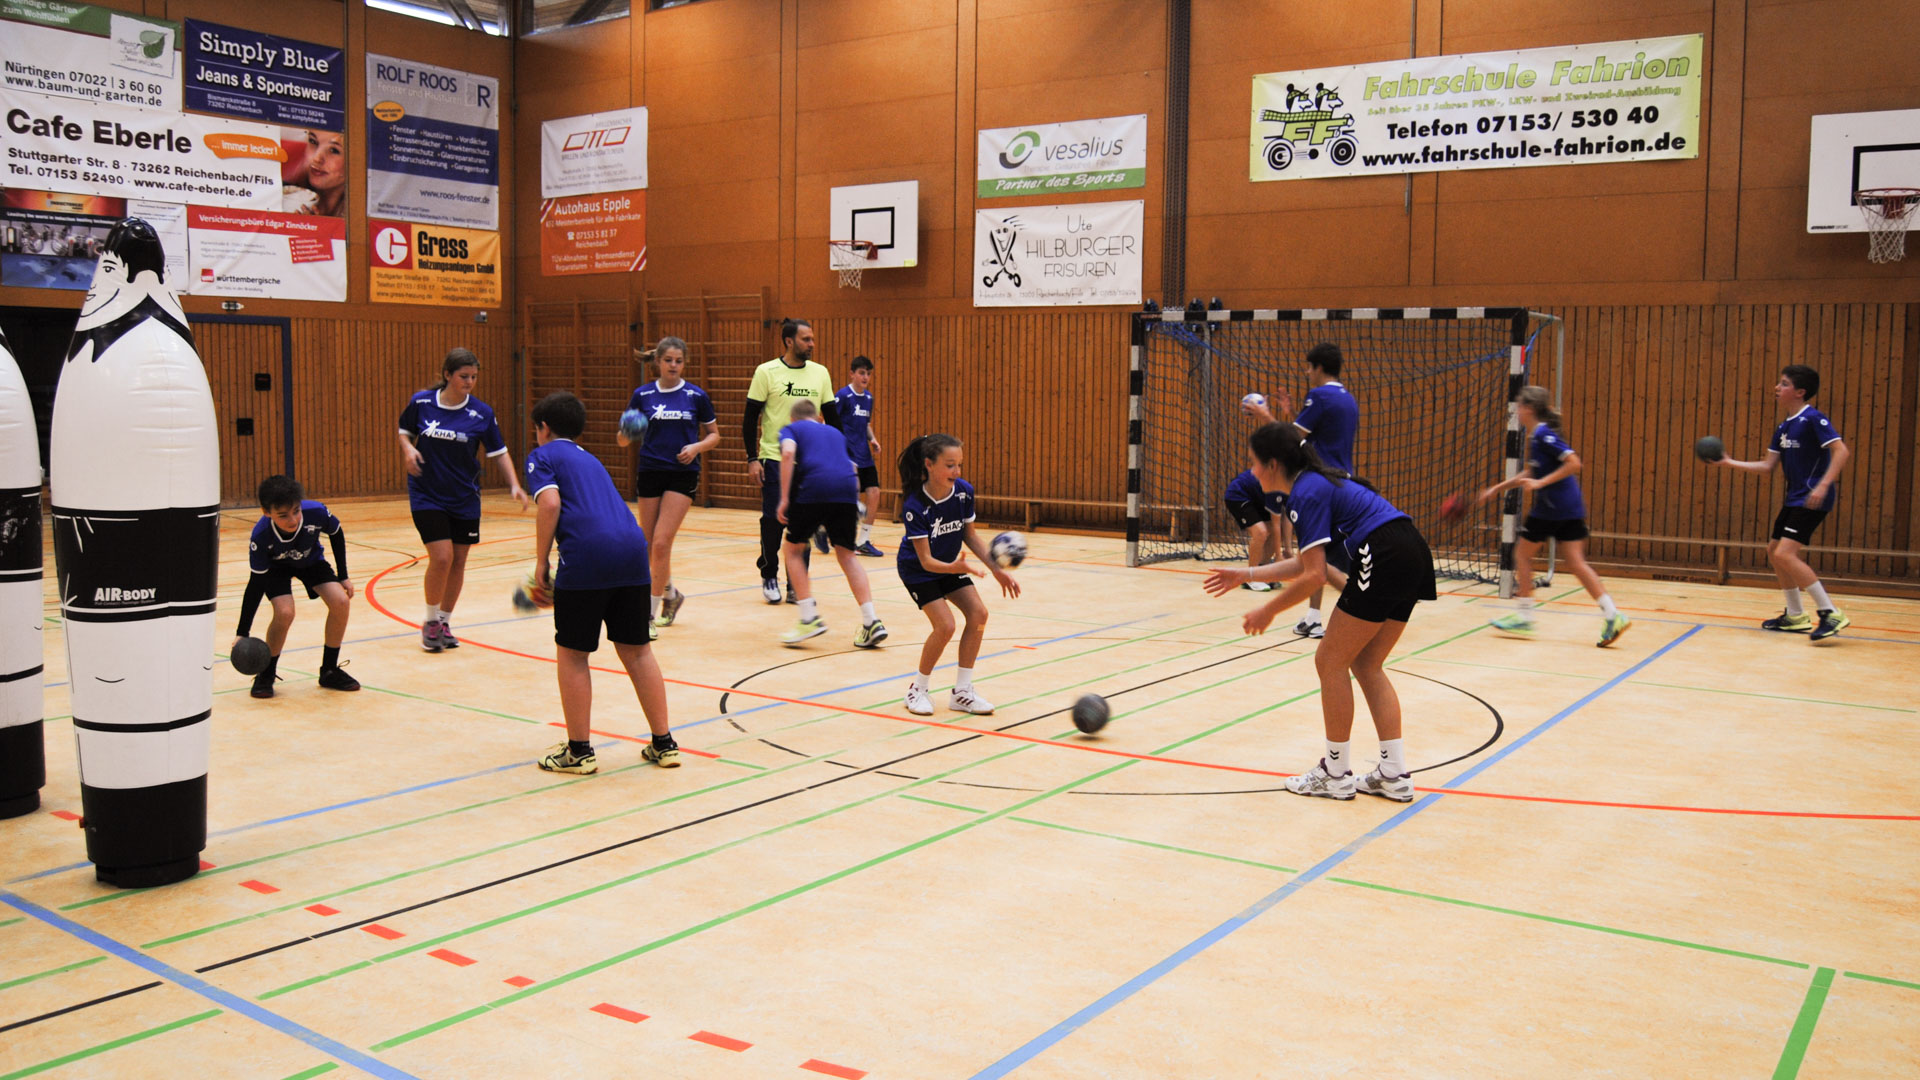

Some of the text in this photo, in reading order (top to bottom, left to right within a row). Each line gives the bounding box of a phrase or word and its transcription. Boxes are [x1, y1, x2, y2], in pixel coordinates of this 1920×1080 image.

[2, 6, 70, 24] zum Wohlfühlen
[48, 2, 78, 14] Gärten
[200, 31, 329, 73] Simply Blue
[5, 60, 66, 80] Nürtingen
[69, 71, 107, 87] 07022
[118, 79, 126, 90] 3
[129, 81, 144, 93] 60
[147, 84, 162, 95] 60
[196, 65, 332, 102] Jeans & Sportswear
[376, 63, 415, 85] ROLF
[419, 72, 458, 93] ROOS
[1363, 52, 1690, 100] Fahrschule Fahrion
[5, 75, 162, 107] www.baum-und-garten.de
[1433, 100, 1468, 110] Jahren
[1541, 93, 1562, 103] und
[1565, 86, 1682, 102] Zweirad-Ausbildung
[6, 108, 192, 153] Cafe Eberle
[392, 125, 416, 135] Fenster
[1387, 105, 1659, 139] Telefon 07153/ 530 40
[222, 140, 248, 152] immer
[392, 145, 434, 157] Sonnenschutz
[1045, 136, 1123, 161] vesalius
[1362, 132, 1686, 166] www.fahrschule-fahrion.de
[8, 147, 274, 186] Stuttgarter Str. 8 73262 Reichenbach/Fils
[392, 154, 490, 174] Einbruchsicherung Garagentore
[8, 164, 253, 198] Tel. 07153 52490 www.cafe-eberle.de
[995, 172, 1127, 191] Partner des Sports
[419, 189, 491, 204] www.roos-fenster.de
[554, 196, 631, 216] Autohaus Epple
[199, 214, 318, 231] Versicherungsbüro Edgar Zinnöcker
[1067, 214, 1092, 234] Ute
[375, 227, 408, 265] G
[417, 230, 469, 259] Gress
[1026, 235, 1136, 259] HILBURGER
[418, 258, 495, 274] Heizungsanlagen GmbH
[1044, 262, 1116, 277] FRISUREN
[216, 274, 281, 286] württembergische
[94, 587, 156, 602] AIR-BODY
